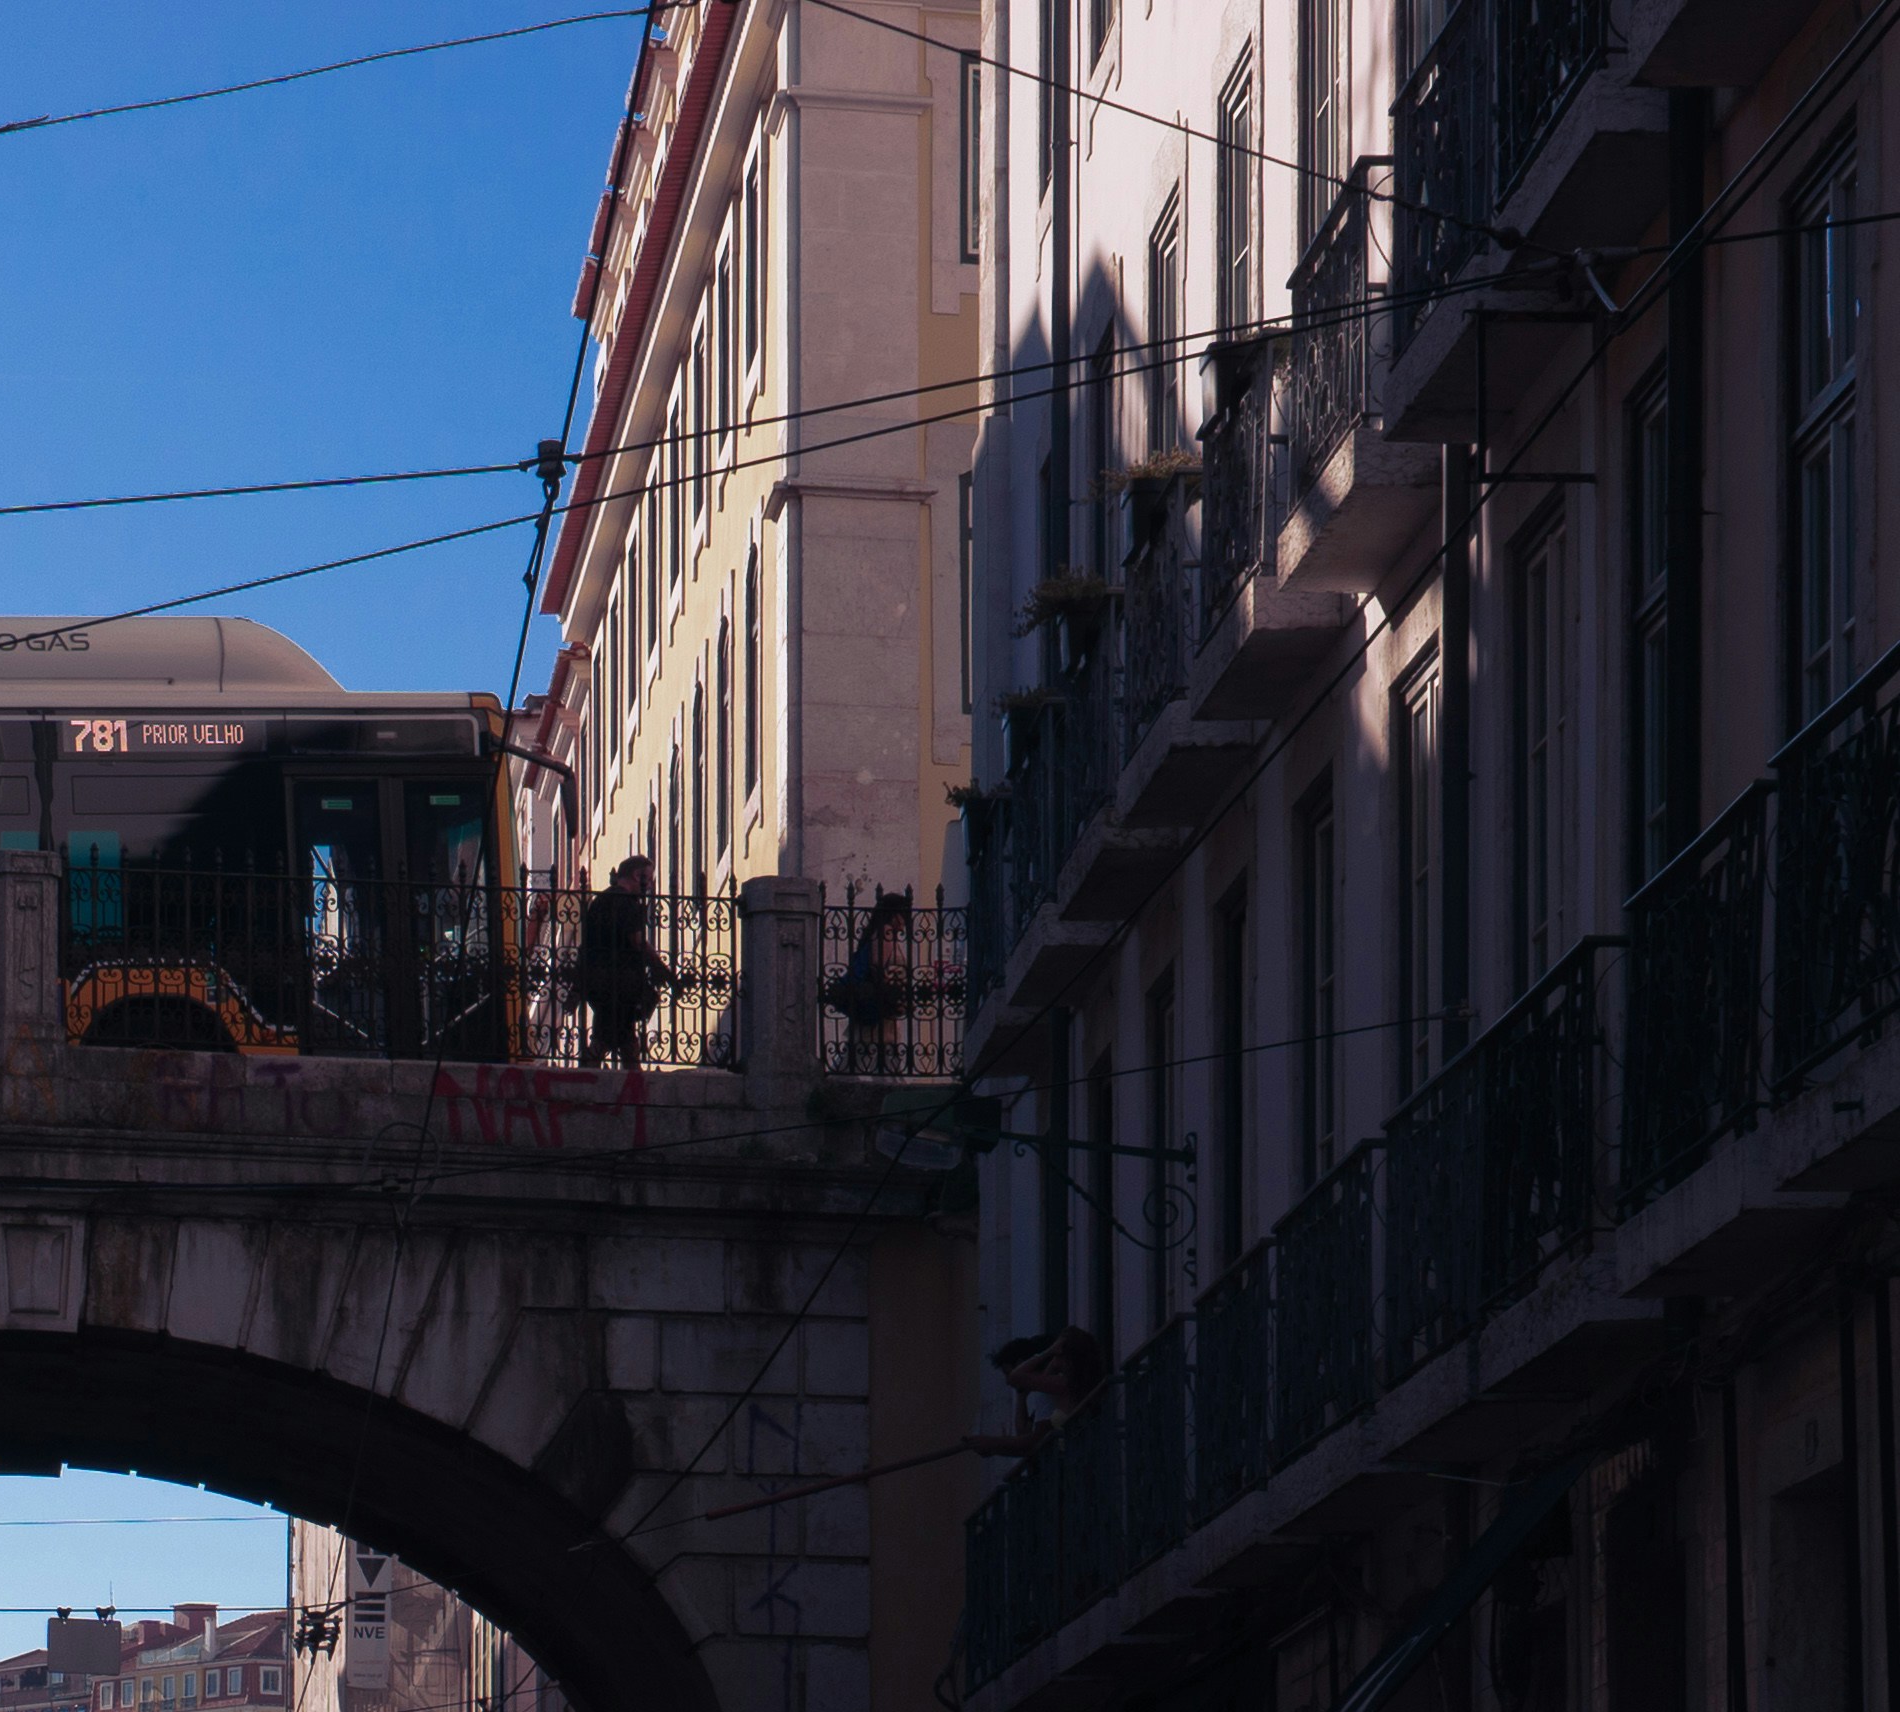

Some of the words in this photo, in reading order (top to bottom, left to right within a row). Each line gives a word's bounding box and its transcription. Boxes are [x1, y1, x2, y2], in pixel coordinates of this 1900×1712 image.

[25, 633, 91, 652] GAS
[70, 719, 129, 752] 781
[142, 724, 189, 745] PRIOR
[193, 724, 245, 745] VELHO
[353, 1626, 386, 1640] NVE
